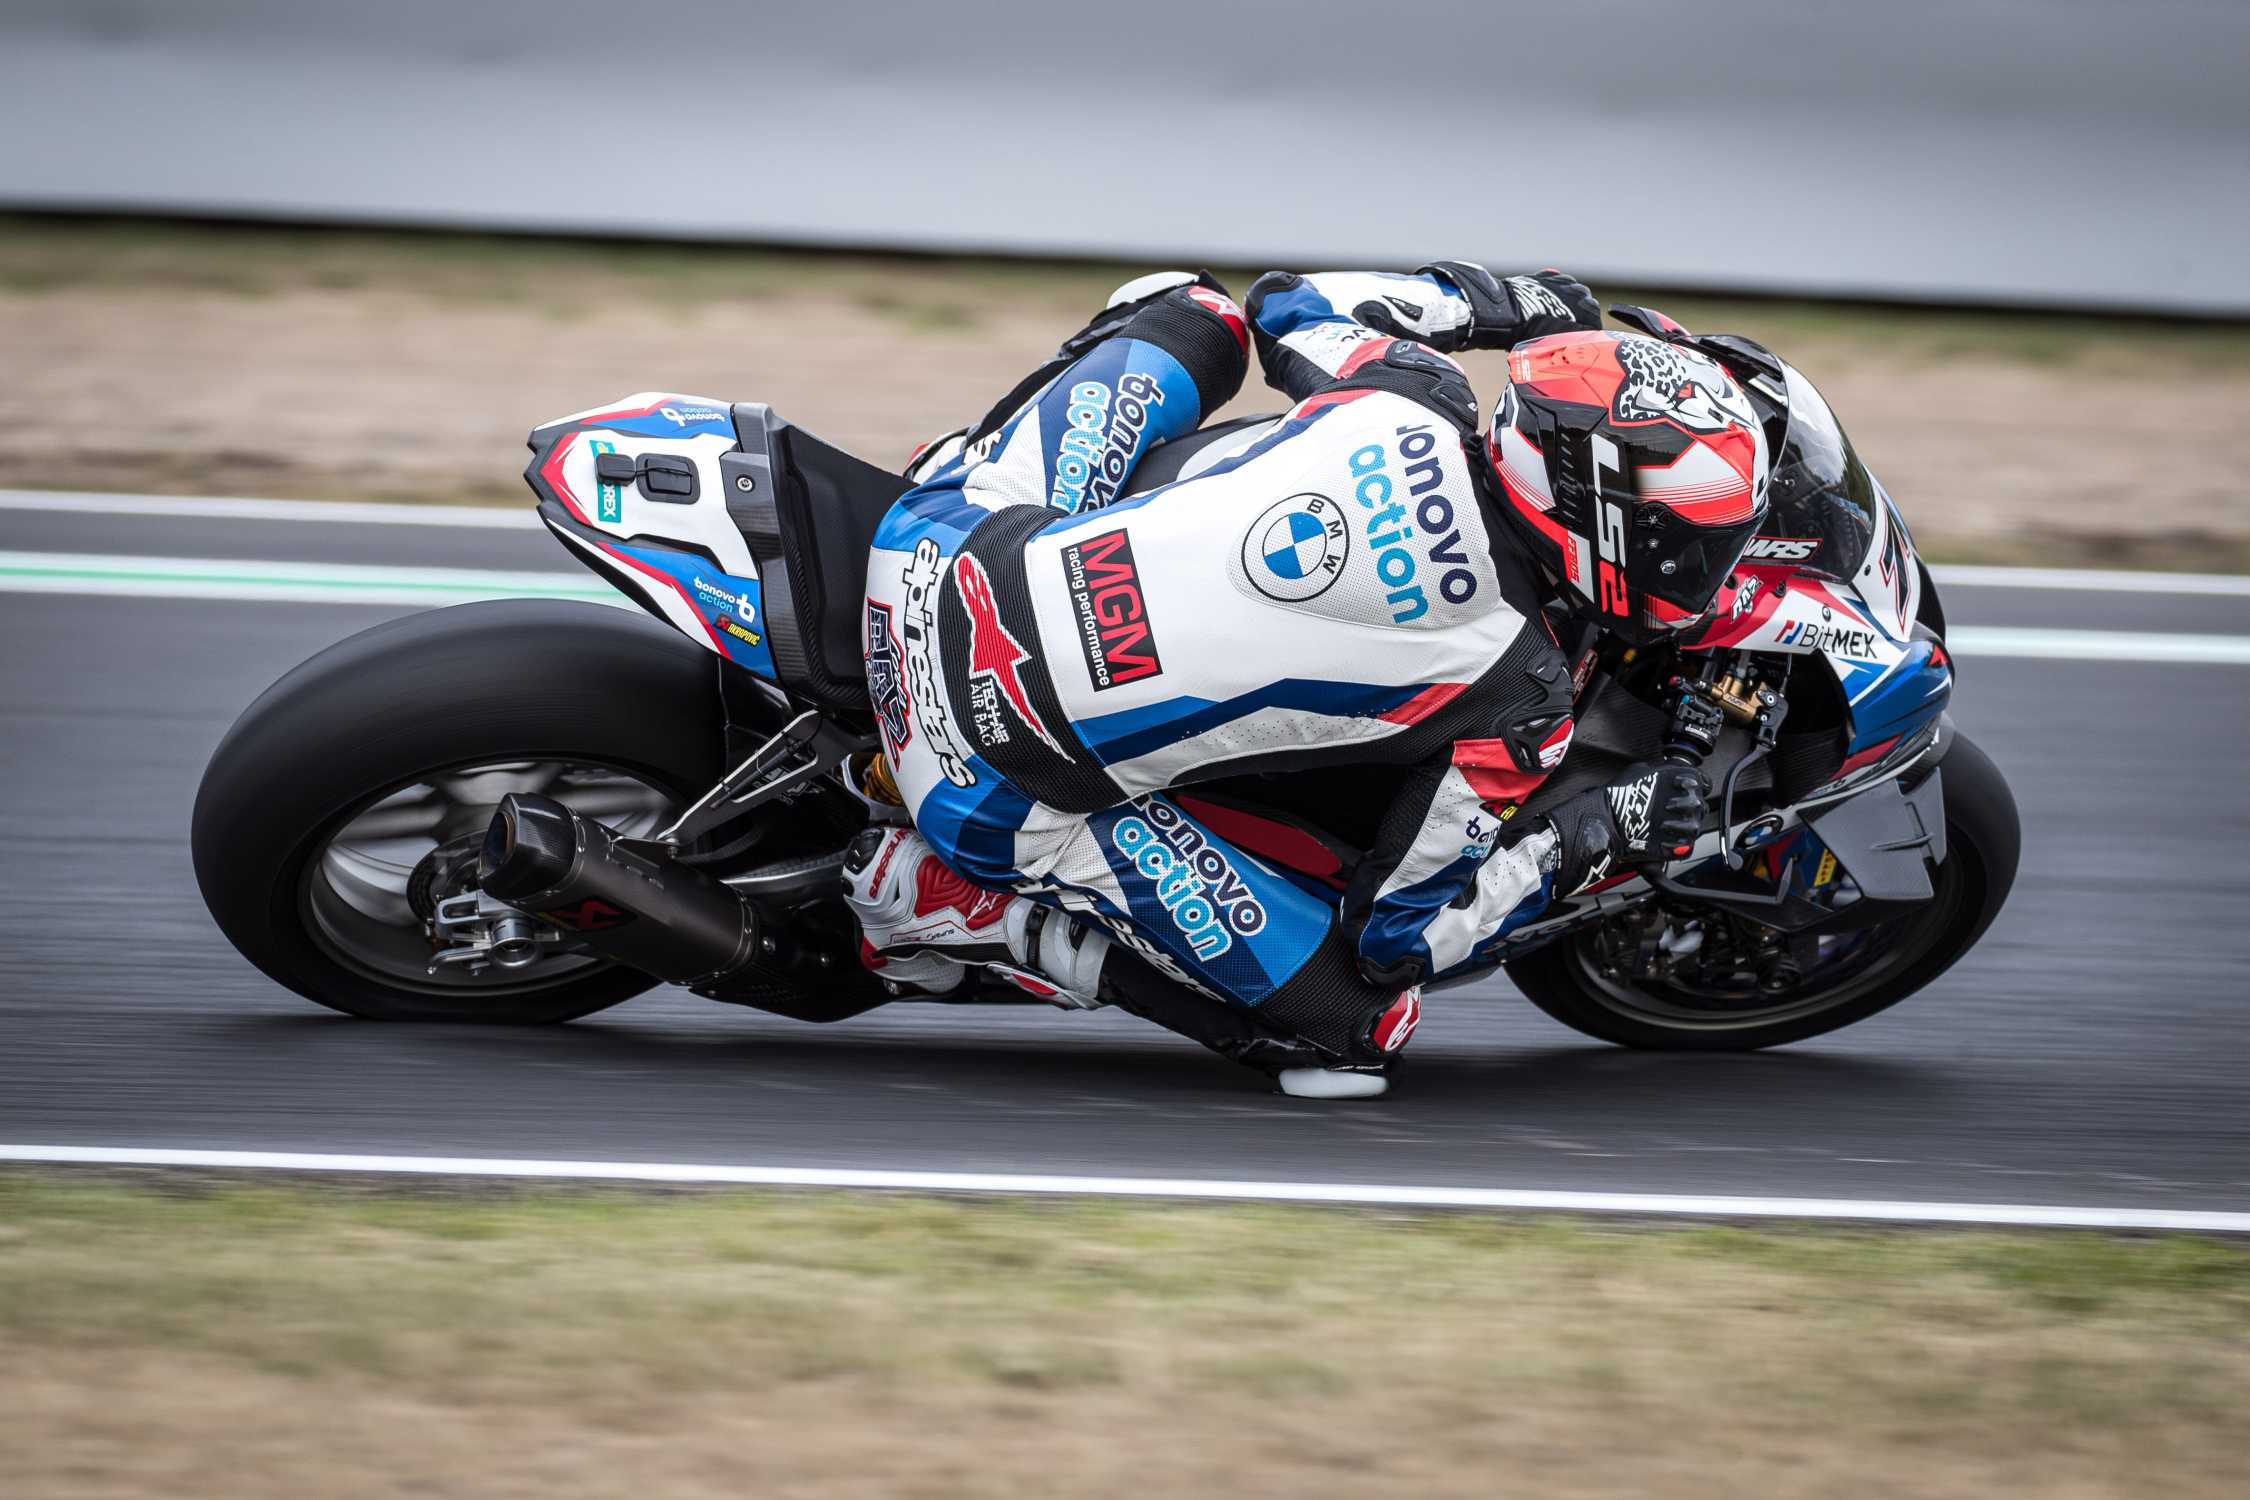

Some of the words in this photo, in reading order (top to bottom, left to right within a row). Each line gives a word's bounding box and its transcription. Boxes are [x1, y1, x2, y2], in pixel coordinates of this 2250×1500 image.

[1348, 444, 1429, 624] action
[1396, 424, 1478, 605] onovo
[1591, 432, 1630, 617] LS2
[1743, 539, 1818, 559] WRS
[694, 576, 735, 603] bonovo
[699, 592, 733, 613] action
[1068, 547, 1086, 592] racing
[1080, 531, 1160, 685] MGM
[903, 537, 978, 788] alpinestars
[1074, 591, 1110, 687] performance
[1800, 624, 1878, 659] BitMEX
[969, 684, 983, 711] AIR
[975, 713, 997, 747] BAG
[1112, 816, 1233, 962] action
[1142, 799, 1266, 936] onovo
